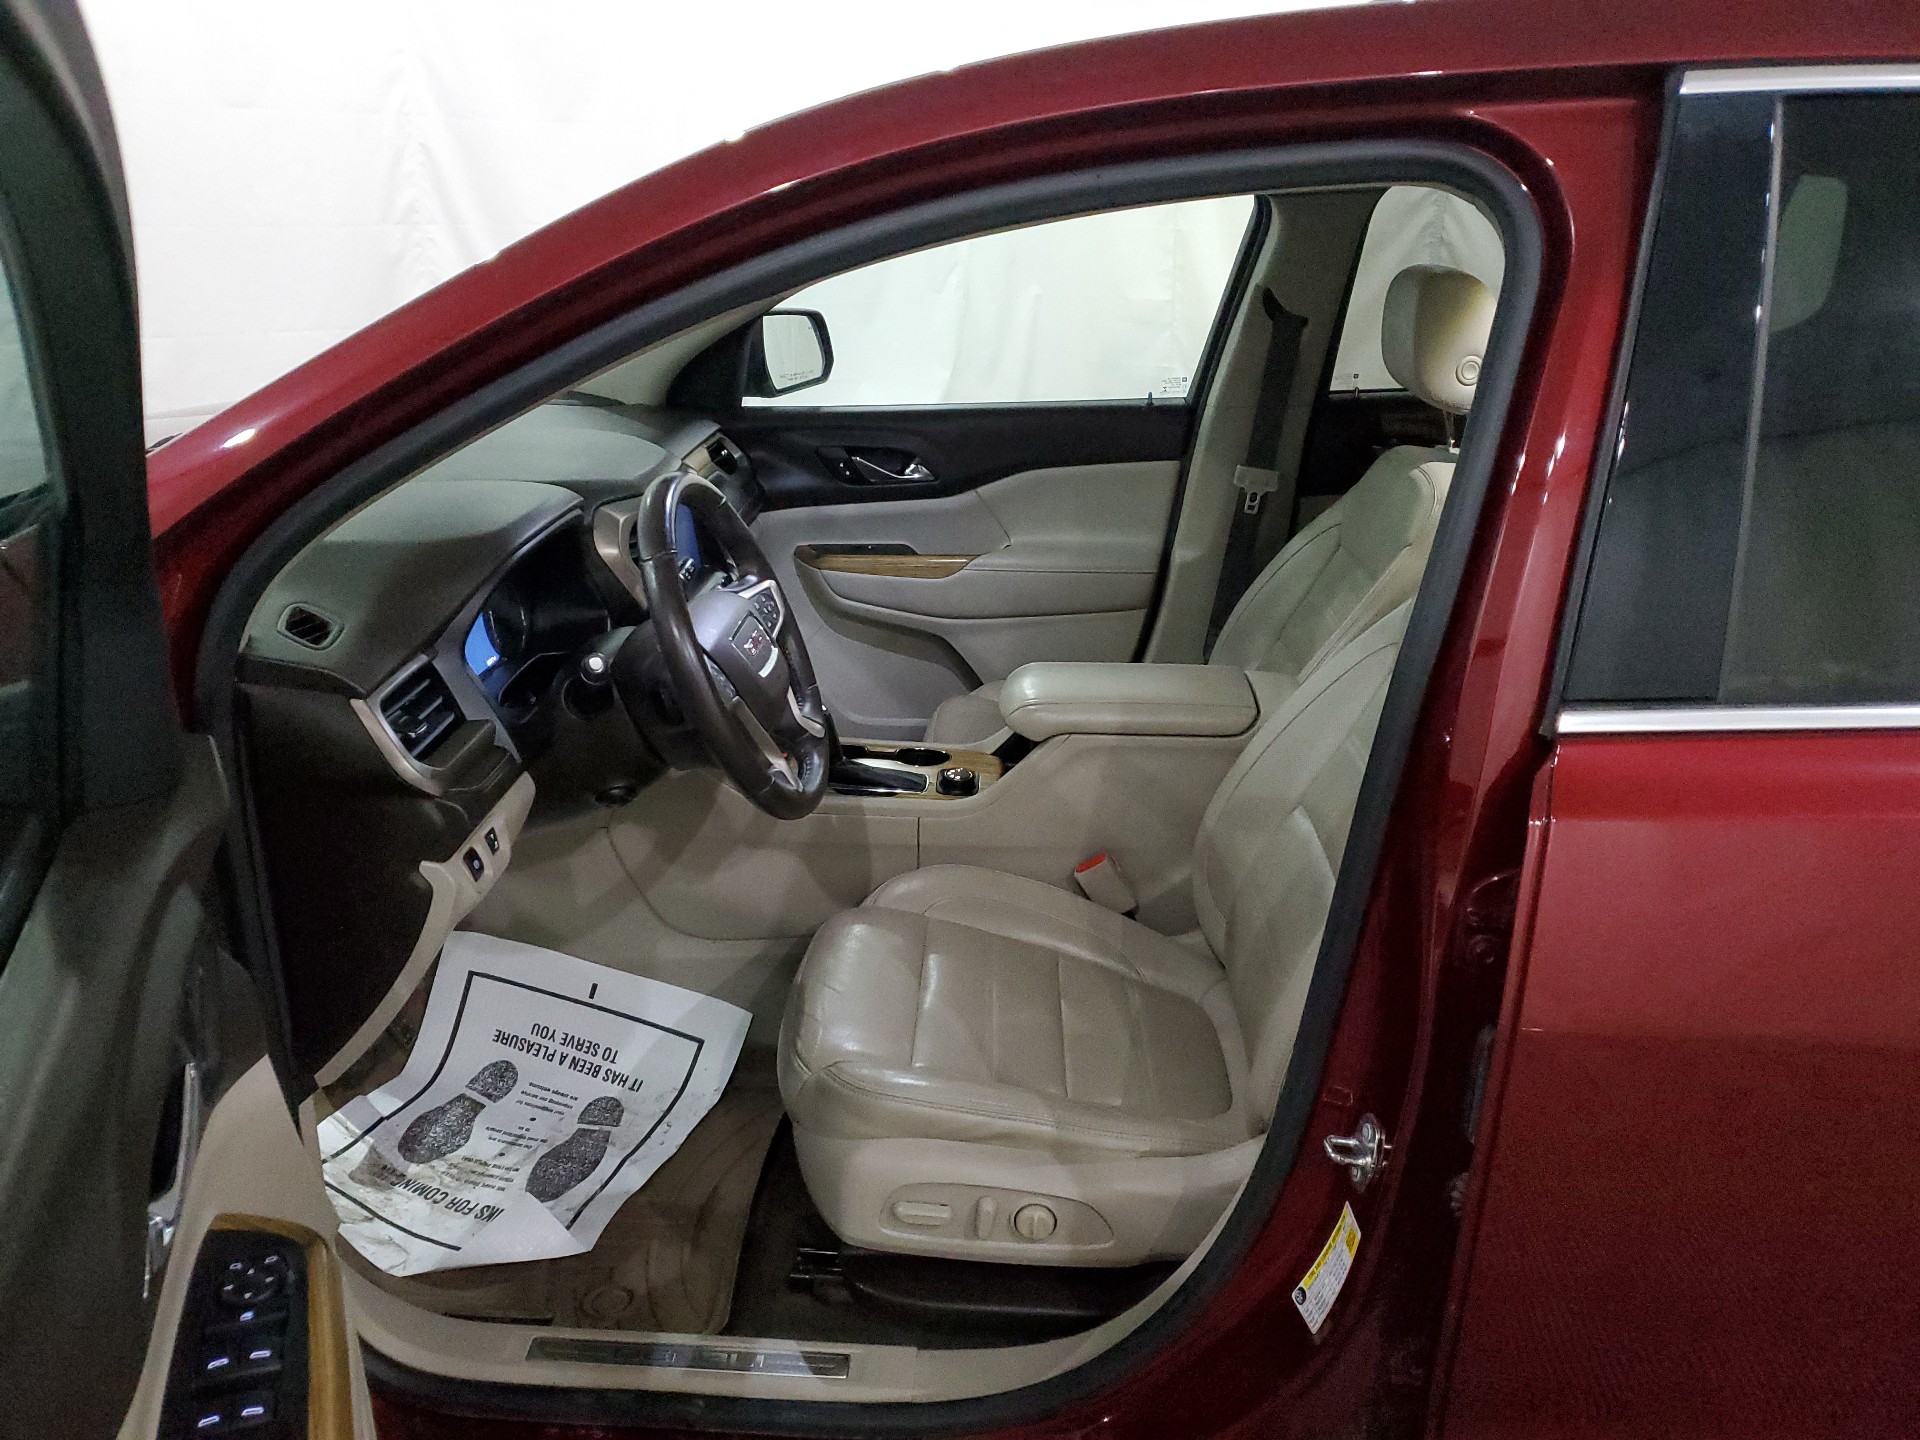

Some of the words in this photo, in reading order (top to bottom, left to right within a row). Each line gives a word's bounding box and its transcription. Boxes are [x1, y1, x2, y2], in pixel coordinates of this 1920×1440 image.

[530, 1023, 556, 1043] YOU
[492, 1028, 556, 1063] PLEASURE
[559, 1032, 600, 1058] SERVE
[601, 1046, 619, 1064] TO
[558, 1052, 569, 1066] A
[568, 1055, 603, 1079] BEEN
[602, 1068, 630, 1088] HAS
[627, 1079, 644, 1093] IT
[445, 1197, 480, 1216] FOR
